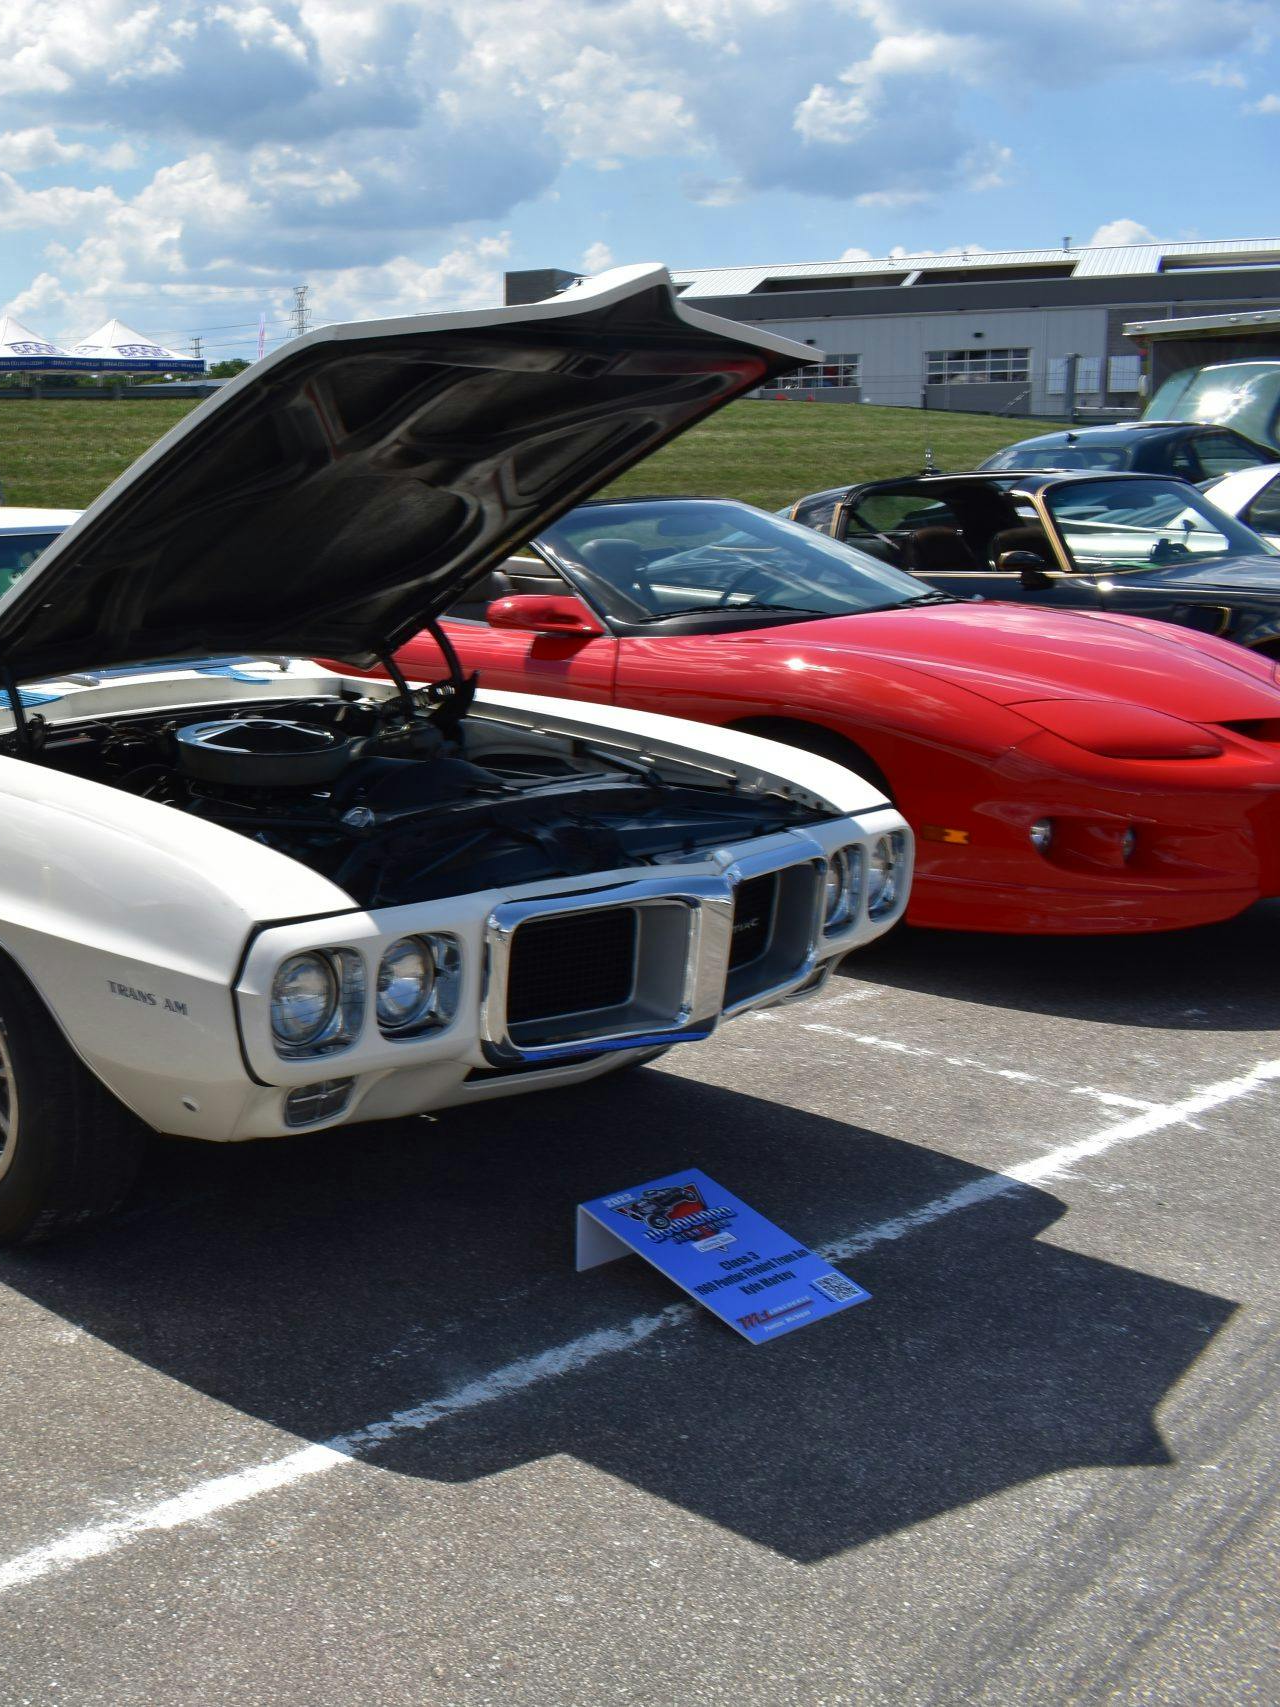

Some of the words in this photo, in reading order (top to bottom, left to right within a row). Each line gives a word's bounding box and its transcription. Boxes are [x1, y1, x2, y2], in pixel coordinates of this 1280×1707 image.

[106, 980, 157, 1006] TRANS
[163, 998, 188, 1016] AM
[713, 1271, 748, 1289] Pontiac
[741, 1259, 778, 1277] Firebird
[770, 1252, 797, 1266] Trans
[719, 1254, 753, 1271] Class
